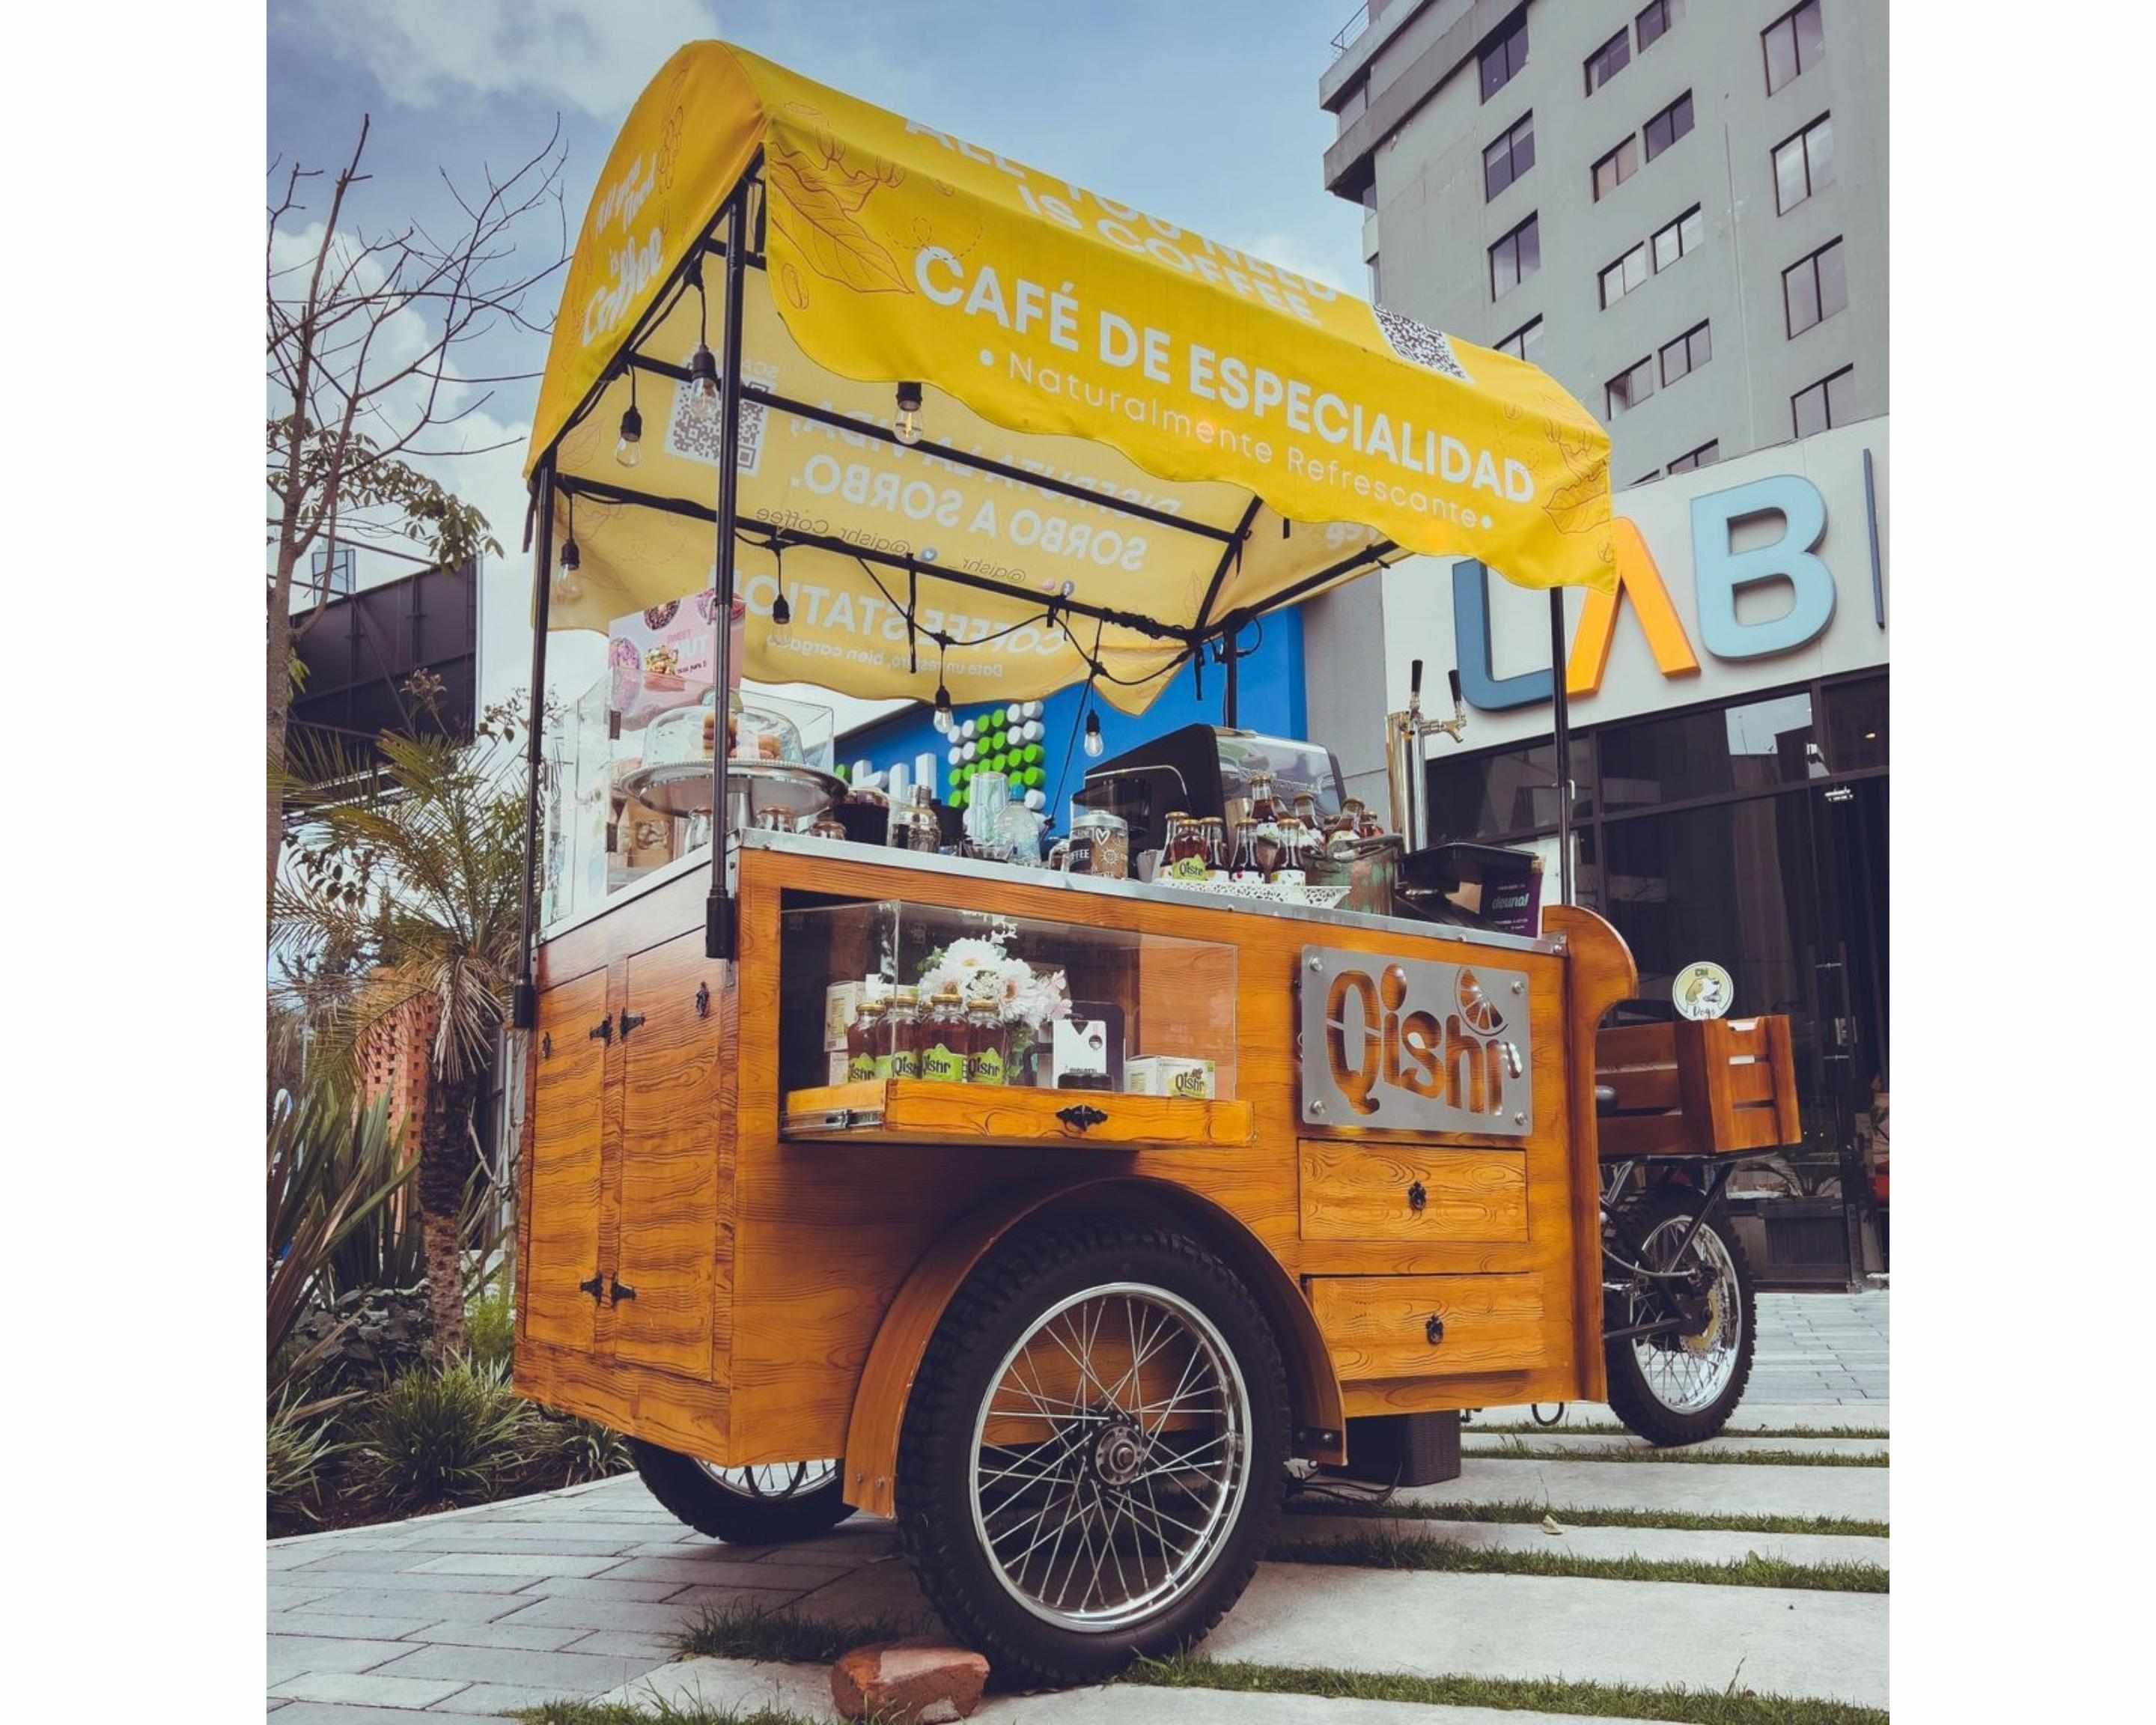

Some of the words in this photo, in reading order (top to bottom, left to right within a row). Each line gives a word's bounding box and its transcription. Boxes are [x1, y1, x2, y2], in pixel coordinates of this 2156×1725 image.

[1066, 184, 1181, 240] OU
[1097, 219, 1324, 326] COFFEE
[916, 246, 1079, 353] CAFÉ
[1099, 311, 1172, 384] DE
[1189, 344, 1535, 504] ESPECIALIDAD
[1009, 352, 1273, 465] Naturalmente
[1288, 446, 1479, 529] Refrescante
[1452, 473, 1838, 712] LAB
[1175, 1071, 1205, 1092] Qishr
[1326, 962, 1523, 1116] Qishr
